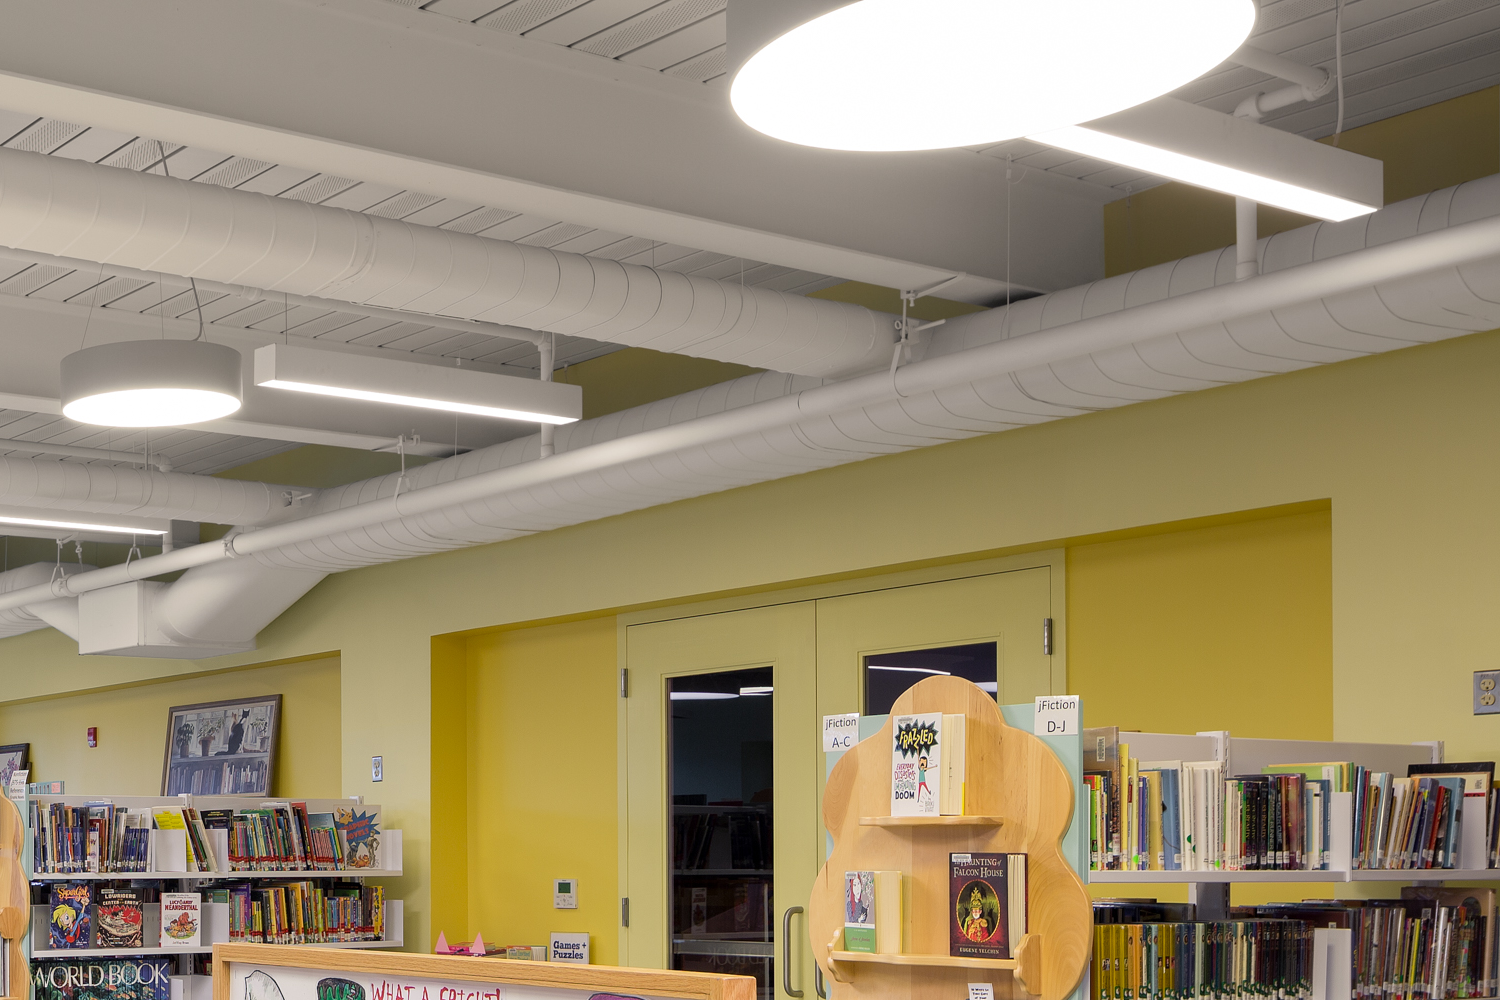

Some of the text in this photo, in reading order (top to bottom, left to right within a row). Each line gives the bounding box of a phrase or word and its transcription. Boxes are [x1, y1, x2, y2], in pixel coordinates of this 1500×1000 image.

[1037, 698, 1077, 713] jFiction
[825, 717, 857, 731] jFiction
[1047, 720, 1066, 733] D-J
[832, 736, 851, 749] A-C
[899, 728, 934, 750] FRAZZLED
[954, 867, 1003, 878] FALCON HOUSE
[553, 940, 580, 950] Games
[553, 950, 584, 959] Puzzles
[30, 963, 169, 989] WORLD BOOK
